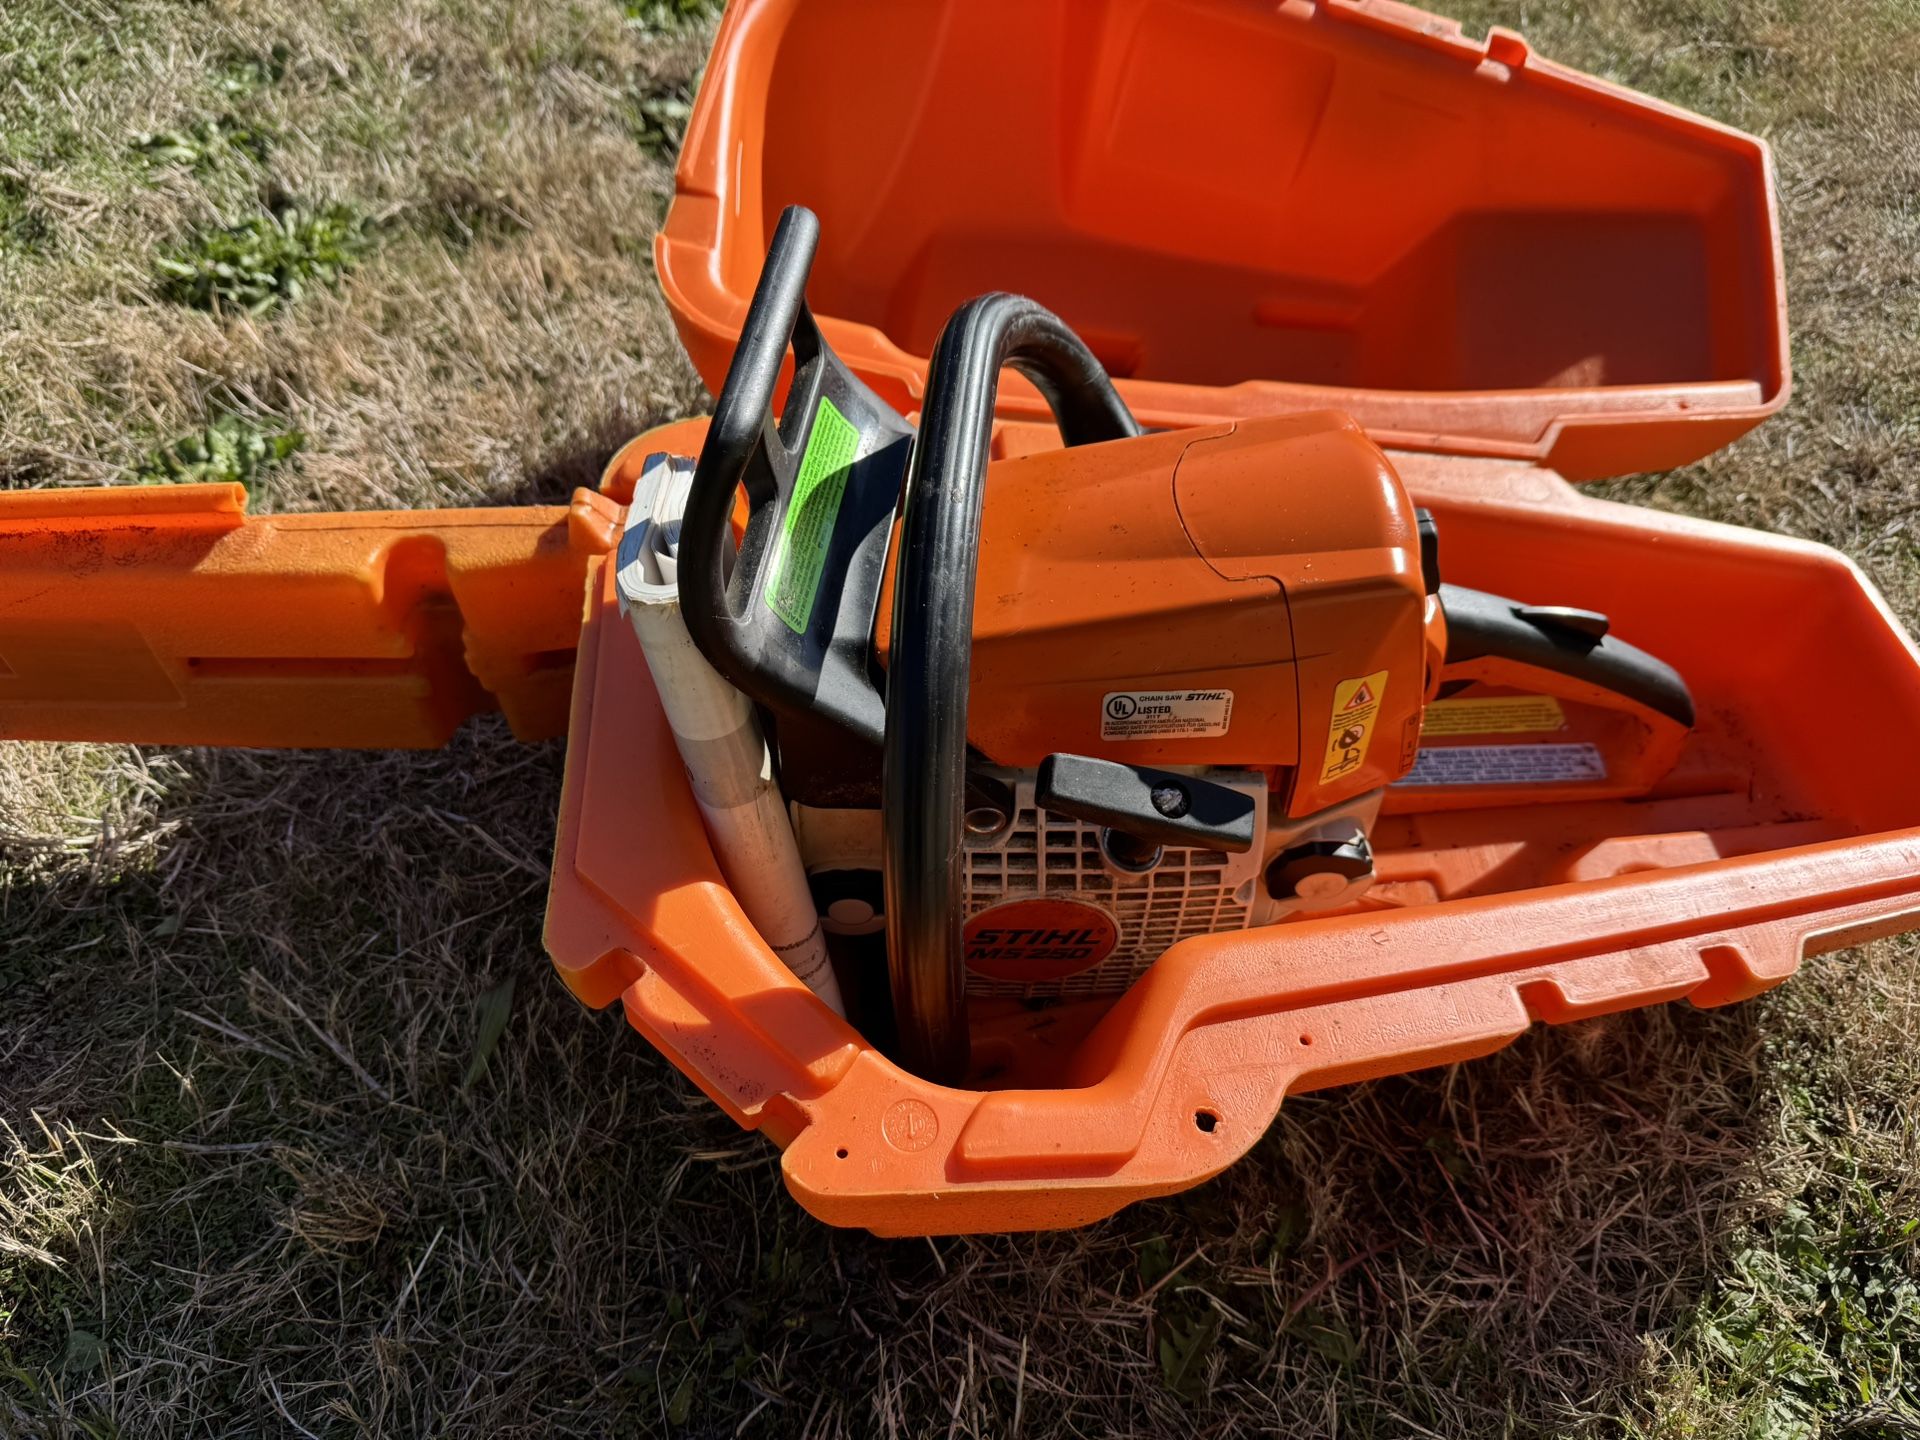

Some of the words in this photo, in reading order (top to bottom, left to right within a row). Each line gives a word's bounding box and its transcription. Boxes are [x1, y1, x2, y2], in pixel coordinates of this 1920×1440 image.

[1185, 692, 1225, 701] STIHL
[1113, 700, 1129, 715] UL
[1137, 705, 1171, 715] LISTED
[968, 928, 1101, 945] STIHL
[967, 947, 1022, 960] MS
[1023, 947, 1092, 960] 250
